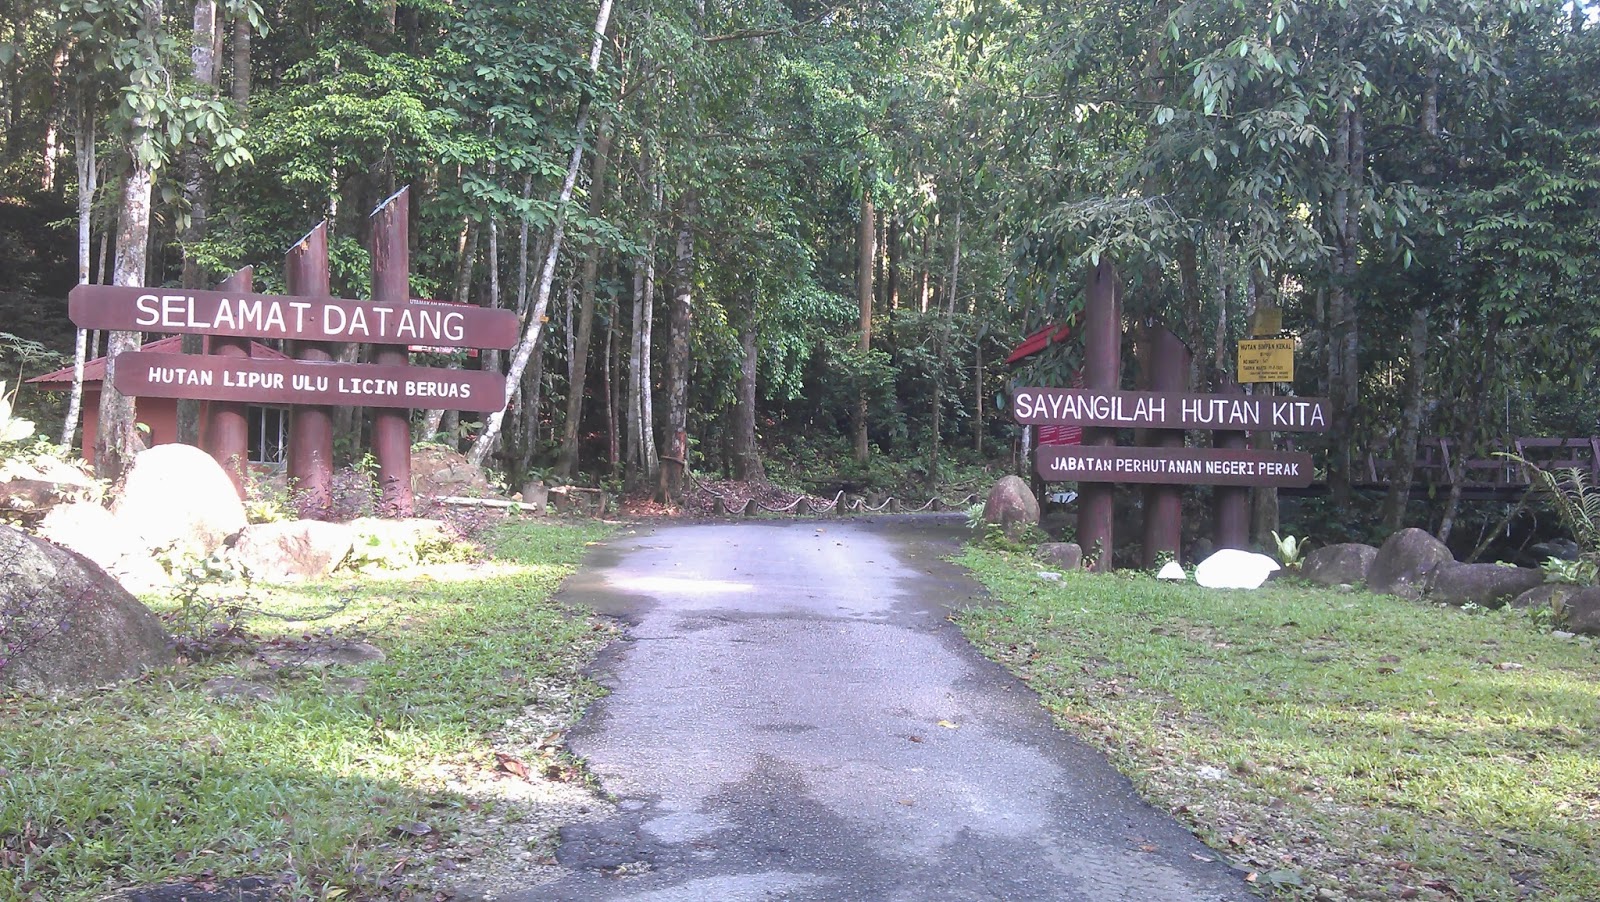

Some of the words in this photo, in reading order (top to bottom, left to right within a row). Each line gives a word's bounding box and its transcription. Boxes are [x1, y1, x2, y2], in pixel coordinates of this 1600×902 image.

[135, 294, 312, 334] SELAMAT
[323, 304, 465, 341] DATANG
[148, 366, 213, 386] HUTAN
[223, 371, 284, 389] LIPUR
[292, 374, 329, 392] ULU
[338, 377, 398, 396] LICIN
[405, 380, 471, 399] BERUAS
[1015, 393, 1166, 422] SAYANGILAH
[1182, 398, 1260, 424] HUTAN
[1272, 402, 1325, 426] KITA
[1050, 456, 1112, 472] JABATAN
[1116, 459, 1202, 474] PERHUTANAN
[1205, 460, 1255, 475] NEGERI
[1258, 462, 1299, 476] PERAK
